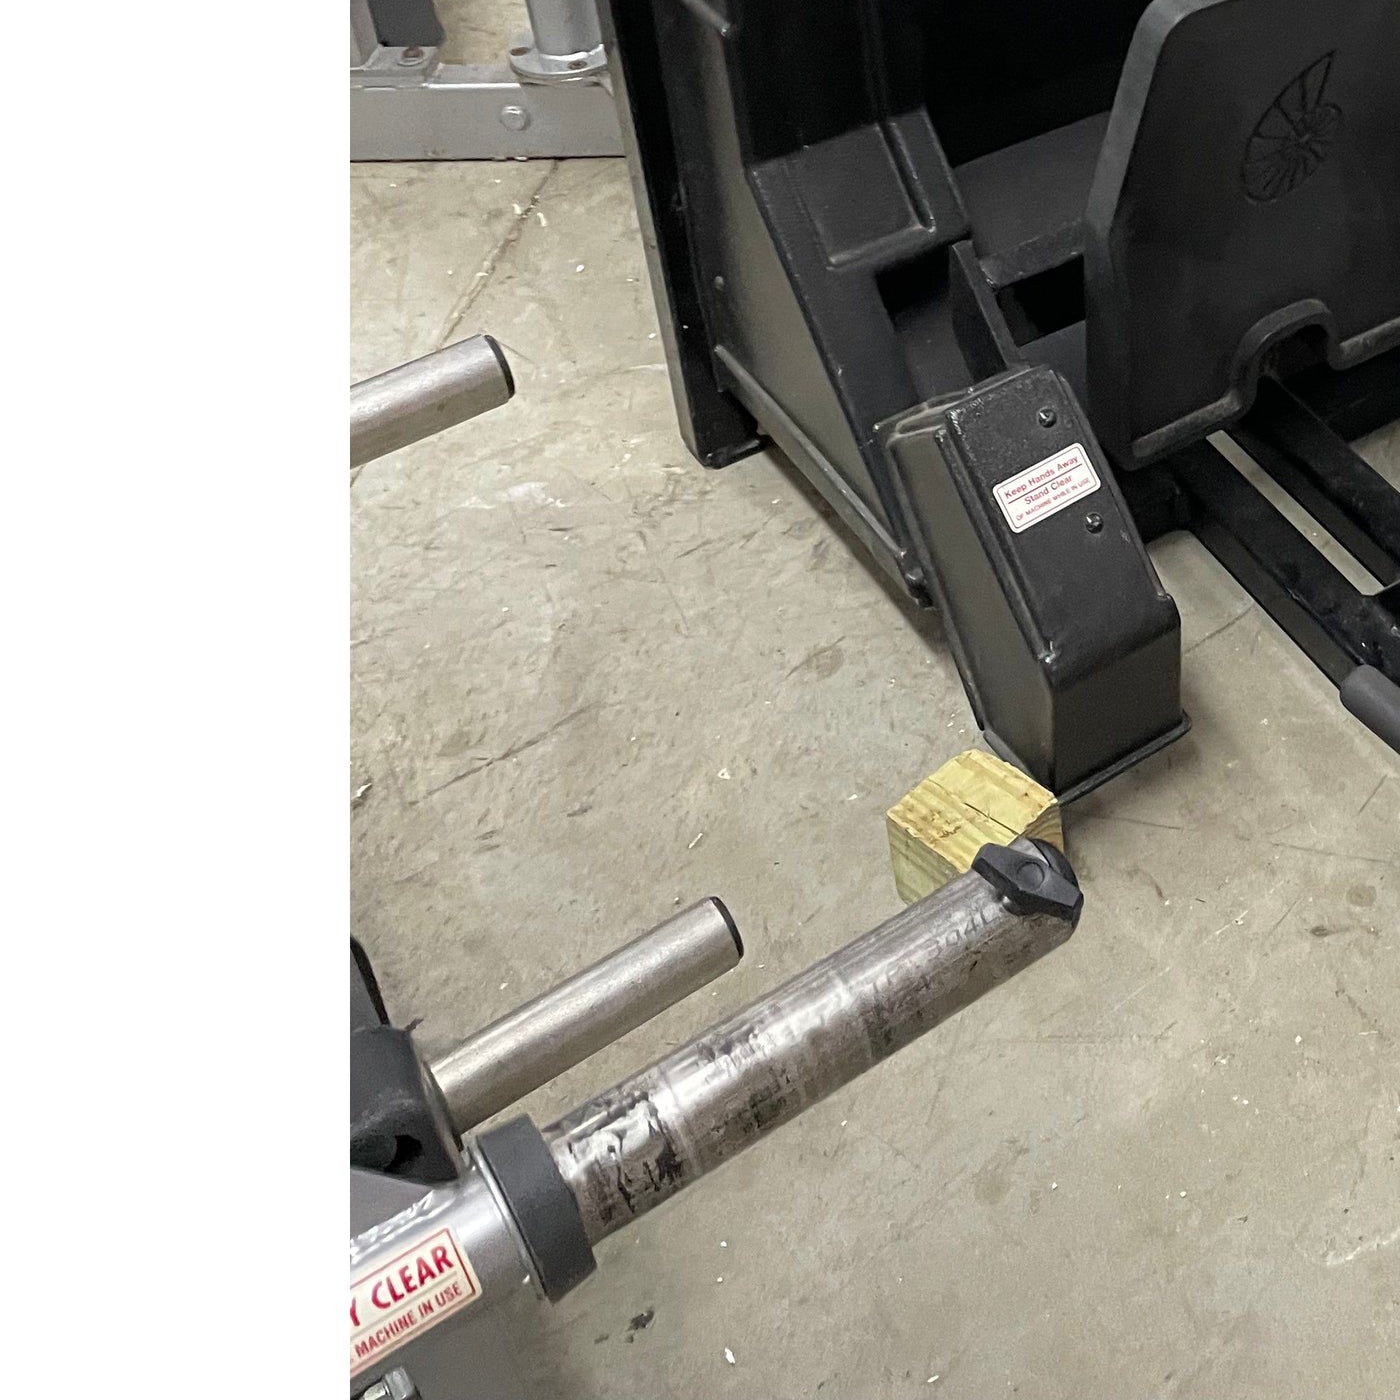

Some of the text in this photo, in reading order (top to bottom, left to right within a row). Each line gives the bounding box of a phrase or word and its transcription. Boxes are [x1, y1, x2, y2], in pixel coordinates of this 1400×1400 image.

[1004, 456, 1078, 499] Keep Hands Away
[1024, 474, 1072, 505] Stand Clear
[371, 1245, 454, 1309] CLEAR
[355, 1281, 463, 1358] MACHINE IN USE
